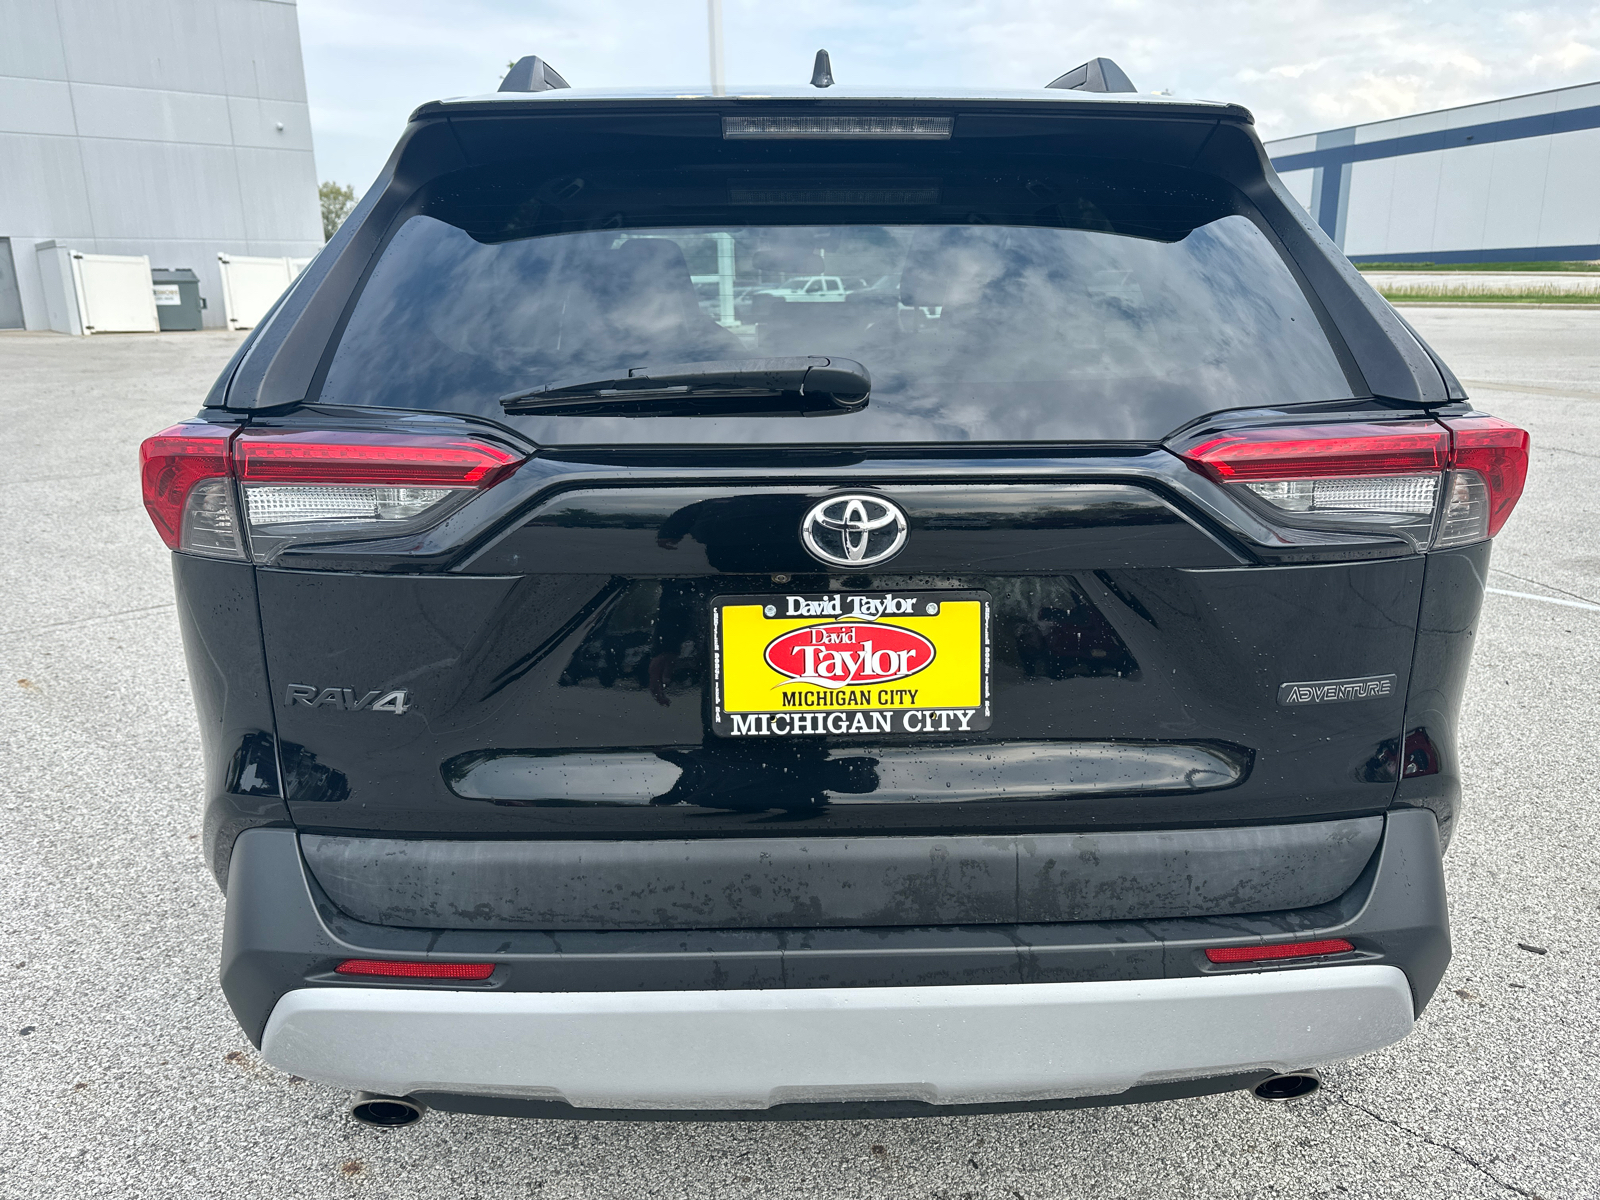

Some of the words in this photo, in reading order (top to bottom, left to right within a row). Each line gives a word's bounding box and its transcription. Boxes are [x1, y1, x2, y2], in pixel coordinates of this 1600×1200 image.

[786, 594, 842, 616] David
[836, 594, 917, 621] Taylor
[810, 627, 857, 645] David
[771, 640, 917, 689] Taylor
[285, 683, 411, 715] RAV4
[782, 690, 872, 707] MICHIGAN
[878, 689, 919, 706] CITY
[1286, 680, 1391, 702] ADVENTURE
[730, 711, 894, 736] MICHIGAN
[903, 709, 976, 732] CITY
